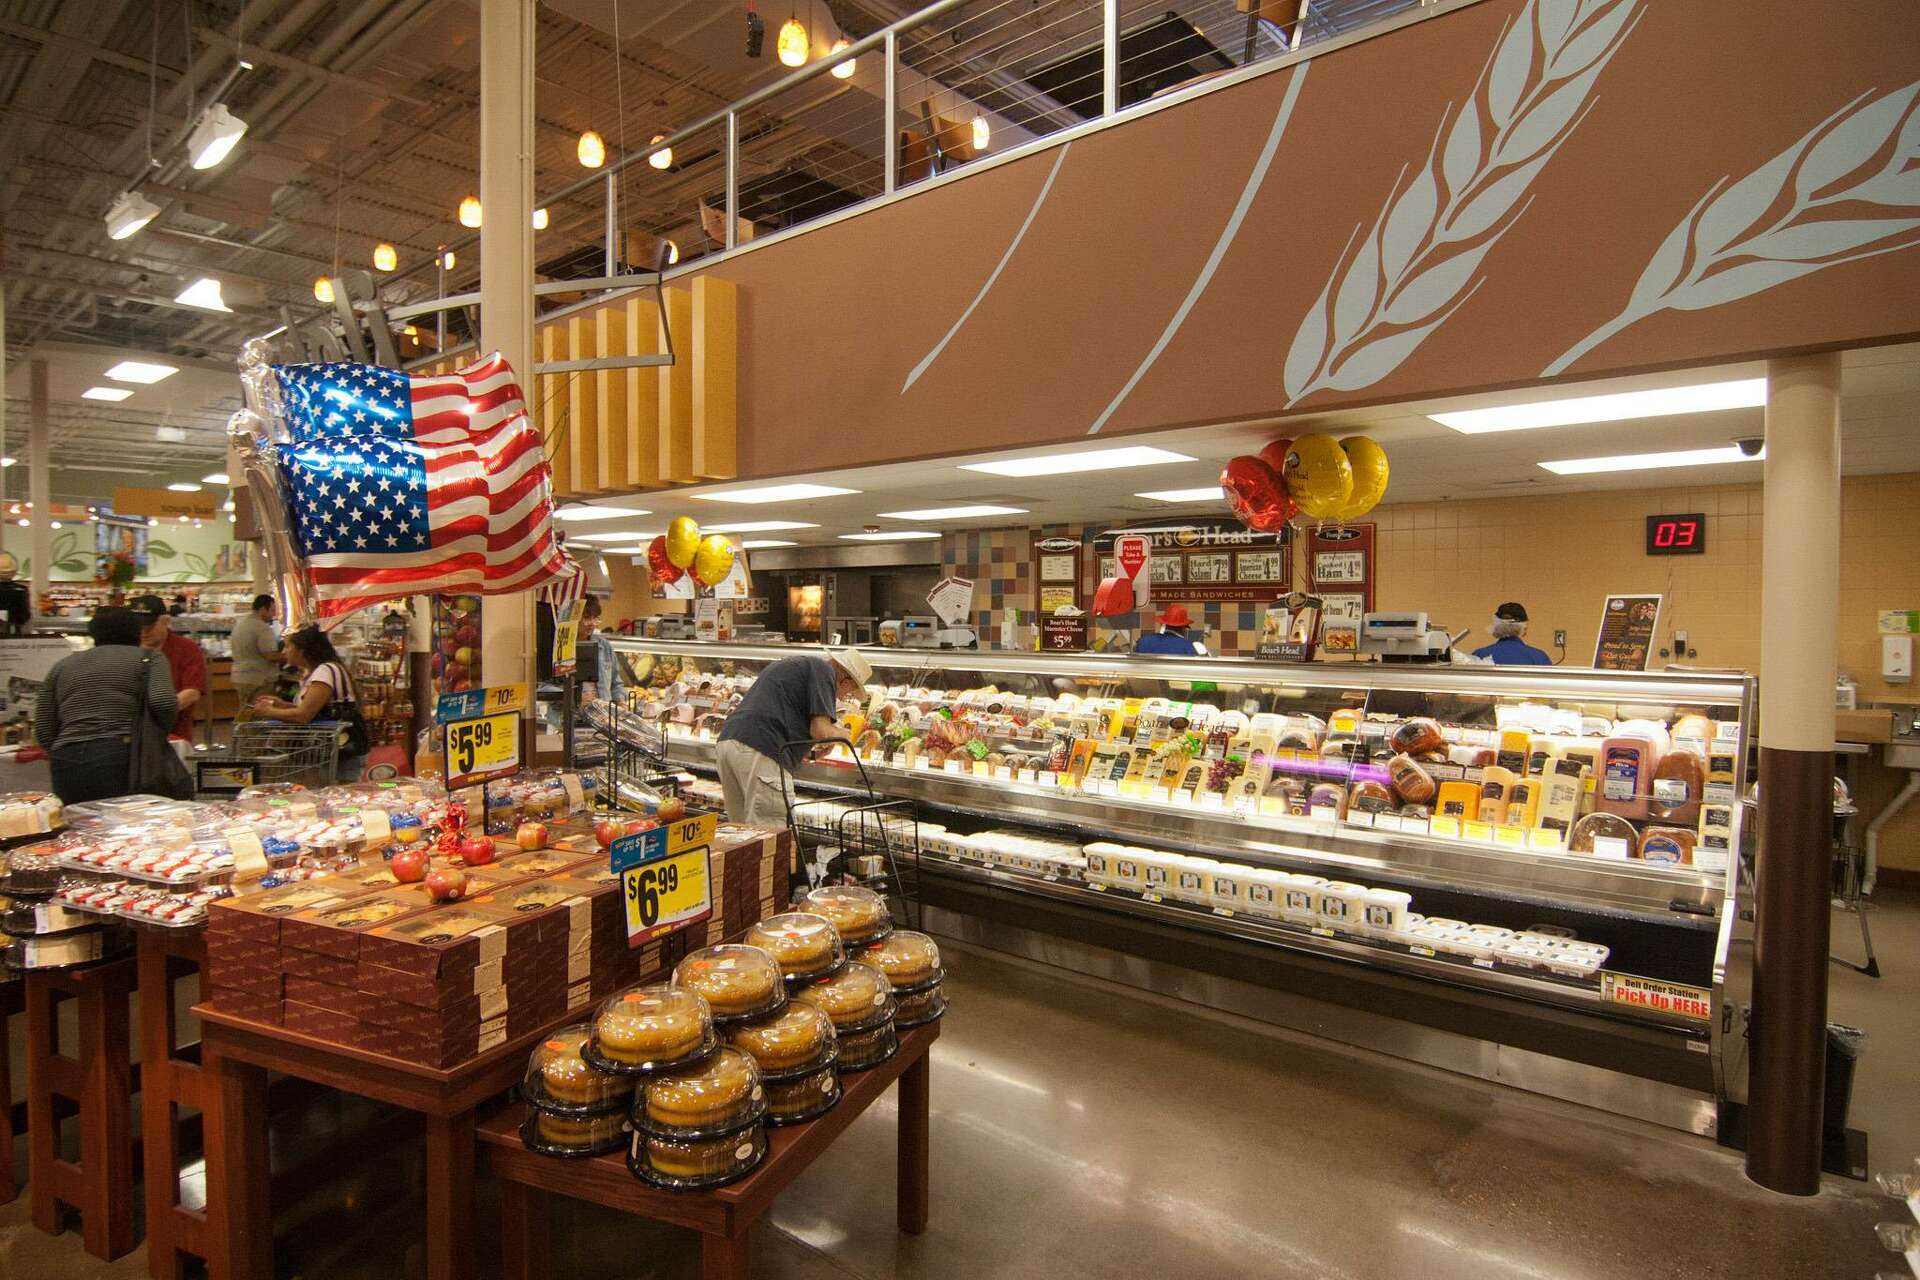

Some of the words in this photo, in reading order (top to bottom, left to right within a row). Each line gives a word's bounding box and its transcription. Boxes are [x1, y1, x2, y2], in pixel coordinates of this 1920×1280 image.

[1201, 525, 1252, 545] Head
[1655, 521, 1697, 547] 03
[1190, 559, 1211, 568] Hard
[1239, 572, 1262, 580] Cheese
[1318, 569, 1343, 578] Ham
[1261, 645, 1280, 654] Boar's
[1281, 645, 1300, 655] Head
[1625, 979, 1641, 989] Deli
[1642, 982, 1667, 994] Order
[1668, 986, 1699, 999] Station
[1672, 996, 1709, 1016] HERE
